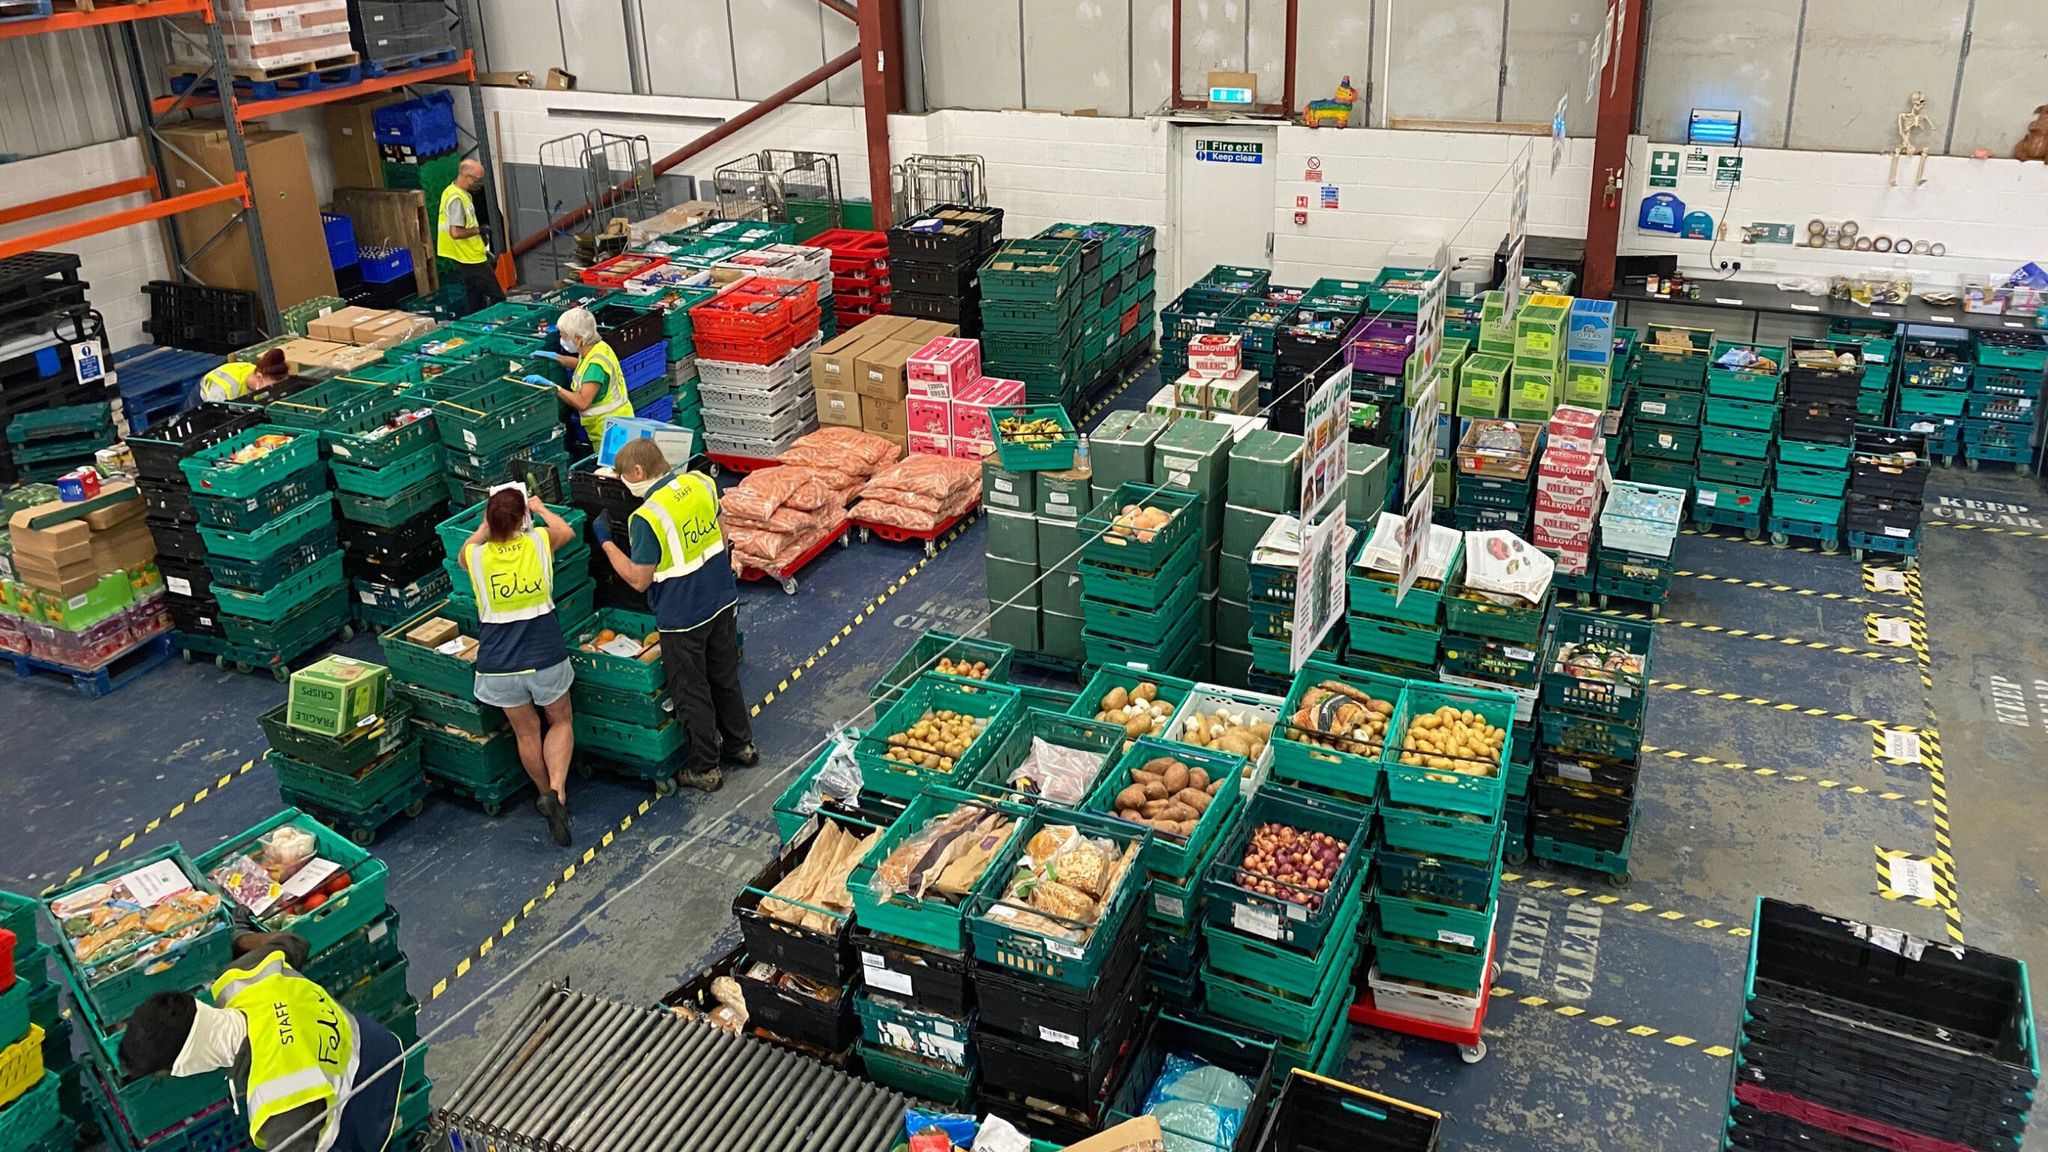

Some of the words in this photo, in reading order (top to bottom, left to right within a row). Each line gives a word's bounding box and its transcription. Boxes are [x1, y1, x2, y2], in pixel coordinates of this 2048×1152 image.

[1212, 142, 1234, 151] Fire
[1236, 143, 1257, 153] exit
[1212, 154, 1233, 162] Keep
[1235, 154, 1256, 162] clear
[1543, 465, 1590, 477] MLEKOVITA
[674, 485, 693, 502] STAFF
[1546, 484, 1584, 495] MLEKO
[1539, 499, 1586, 512] MLEKOVITA
[1939, 496, 2029, 514] KEEP
[1543, 518, 1580, 531] MLEKO
[1932, 507, 2044, 529] CLEAR
[682, 516, 719, 549] Felix
[1536, 534, 1583, 547] MLEKOVITA
[497, 543, 522, 554] STAFF
[490, 572, 542, 600] Felix
[301, 686, 334, 700] CRISPS
[1989, 675, 2030, 728] KEEP
[295, 711, 334, 728] FRAGILE
[1502, 897, 1552, 980] KEEP
[1554, 903, 1604, 1000] CLEAR
[273, 1001, 294, 1046] STAFF
